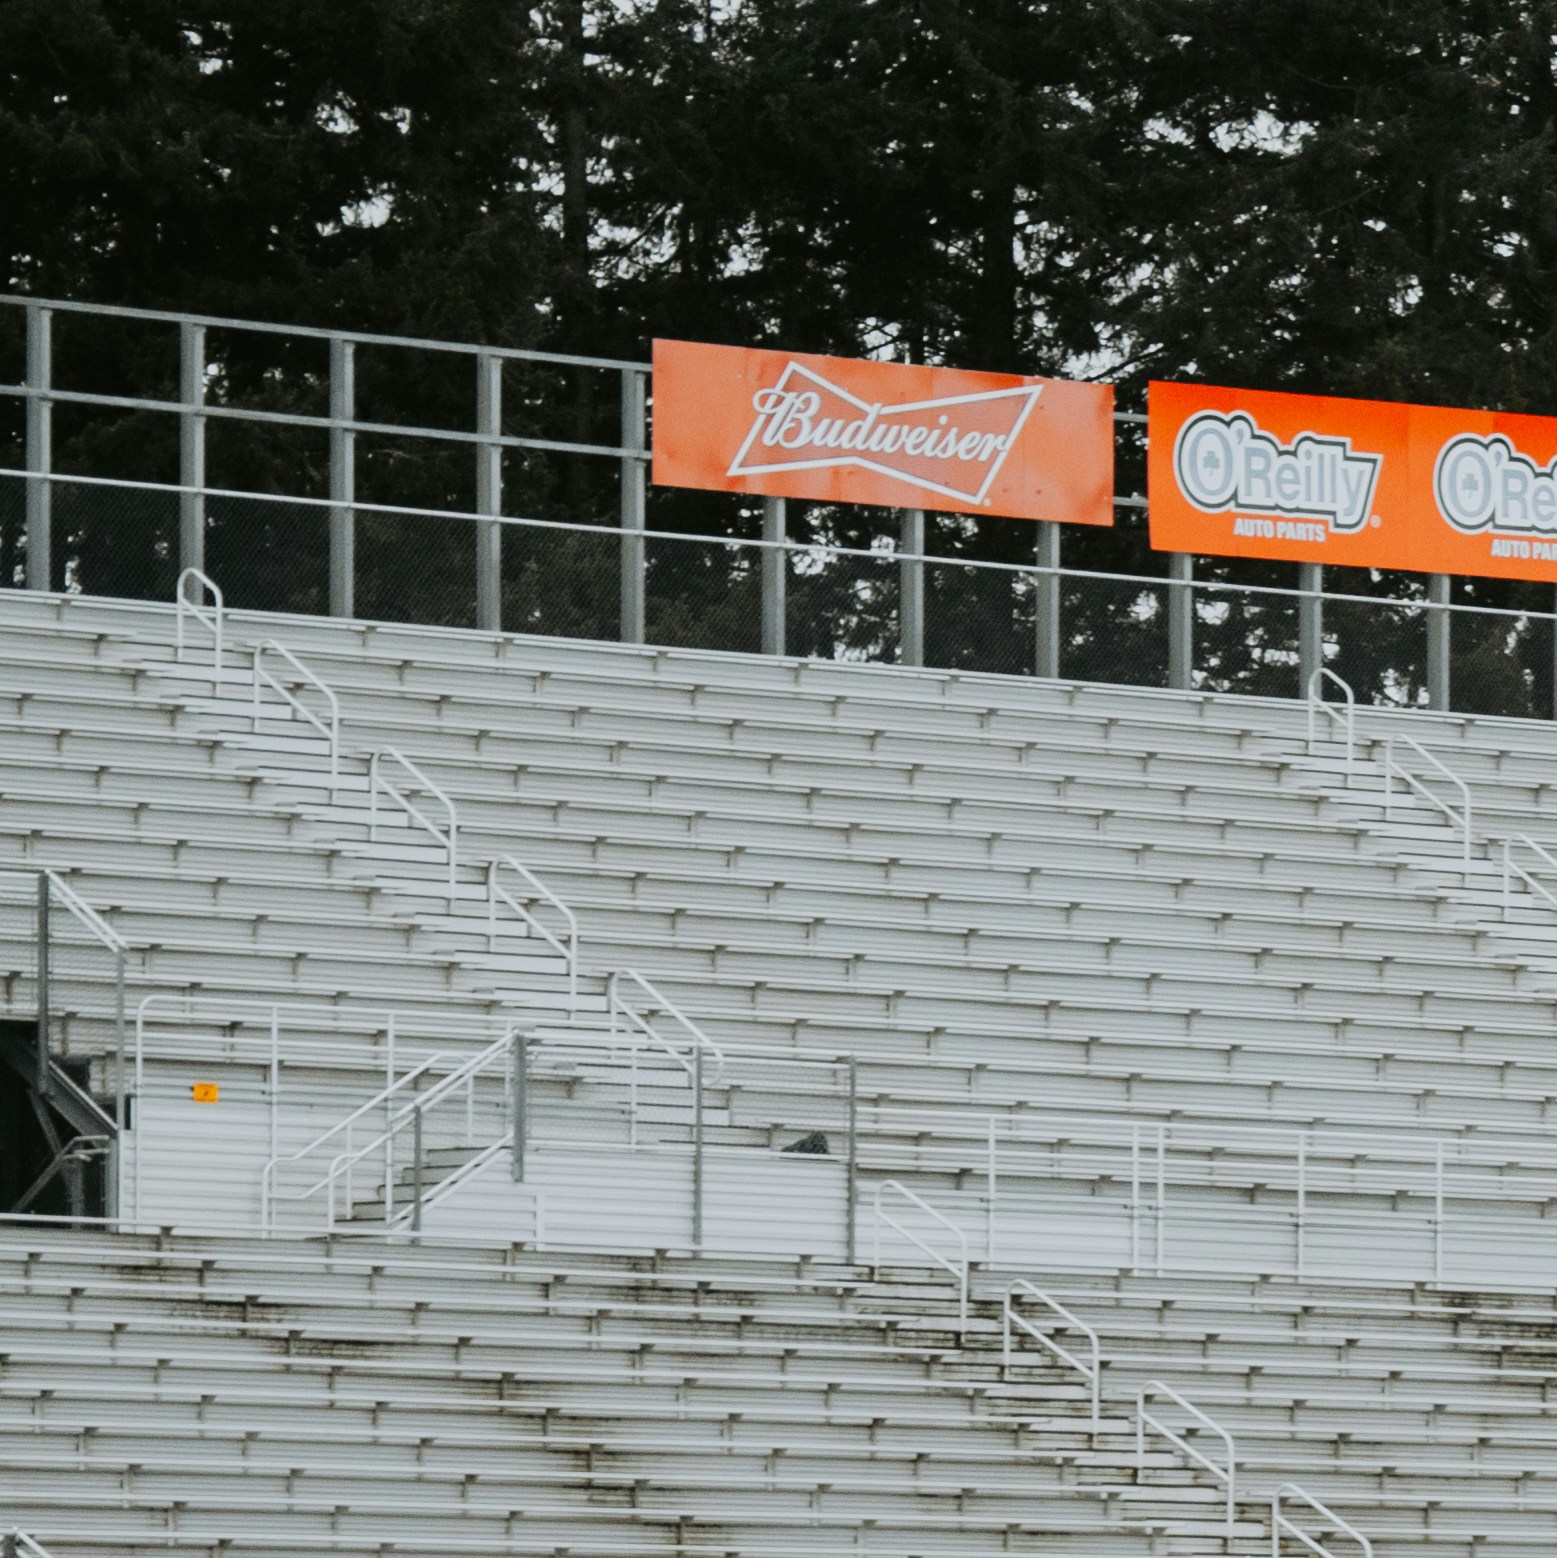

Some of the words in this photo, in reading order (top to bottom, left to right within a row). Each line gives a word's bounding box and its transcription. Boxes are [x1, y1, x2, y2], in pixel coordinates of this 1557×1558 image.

[752, 388, 1007, 461] Budweiser
[1188, 427, 1365, 517] O'Reilly
[1233, 518, 1274, 538] AUTO
[1276, 521, 1326, 542] PARTS
[1491, 539, 1530, 559] AUTO
